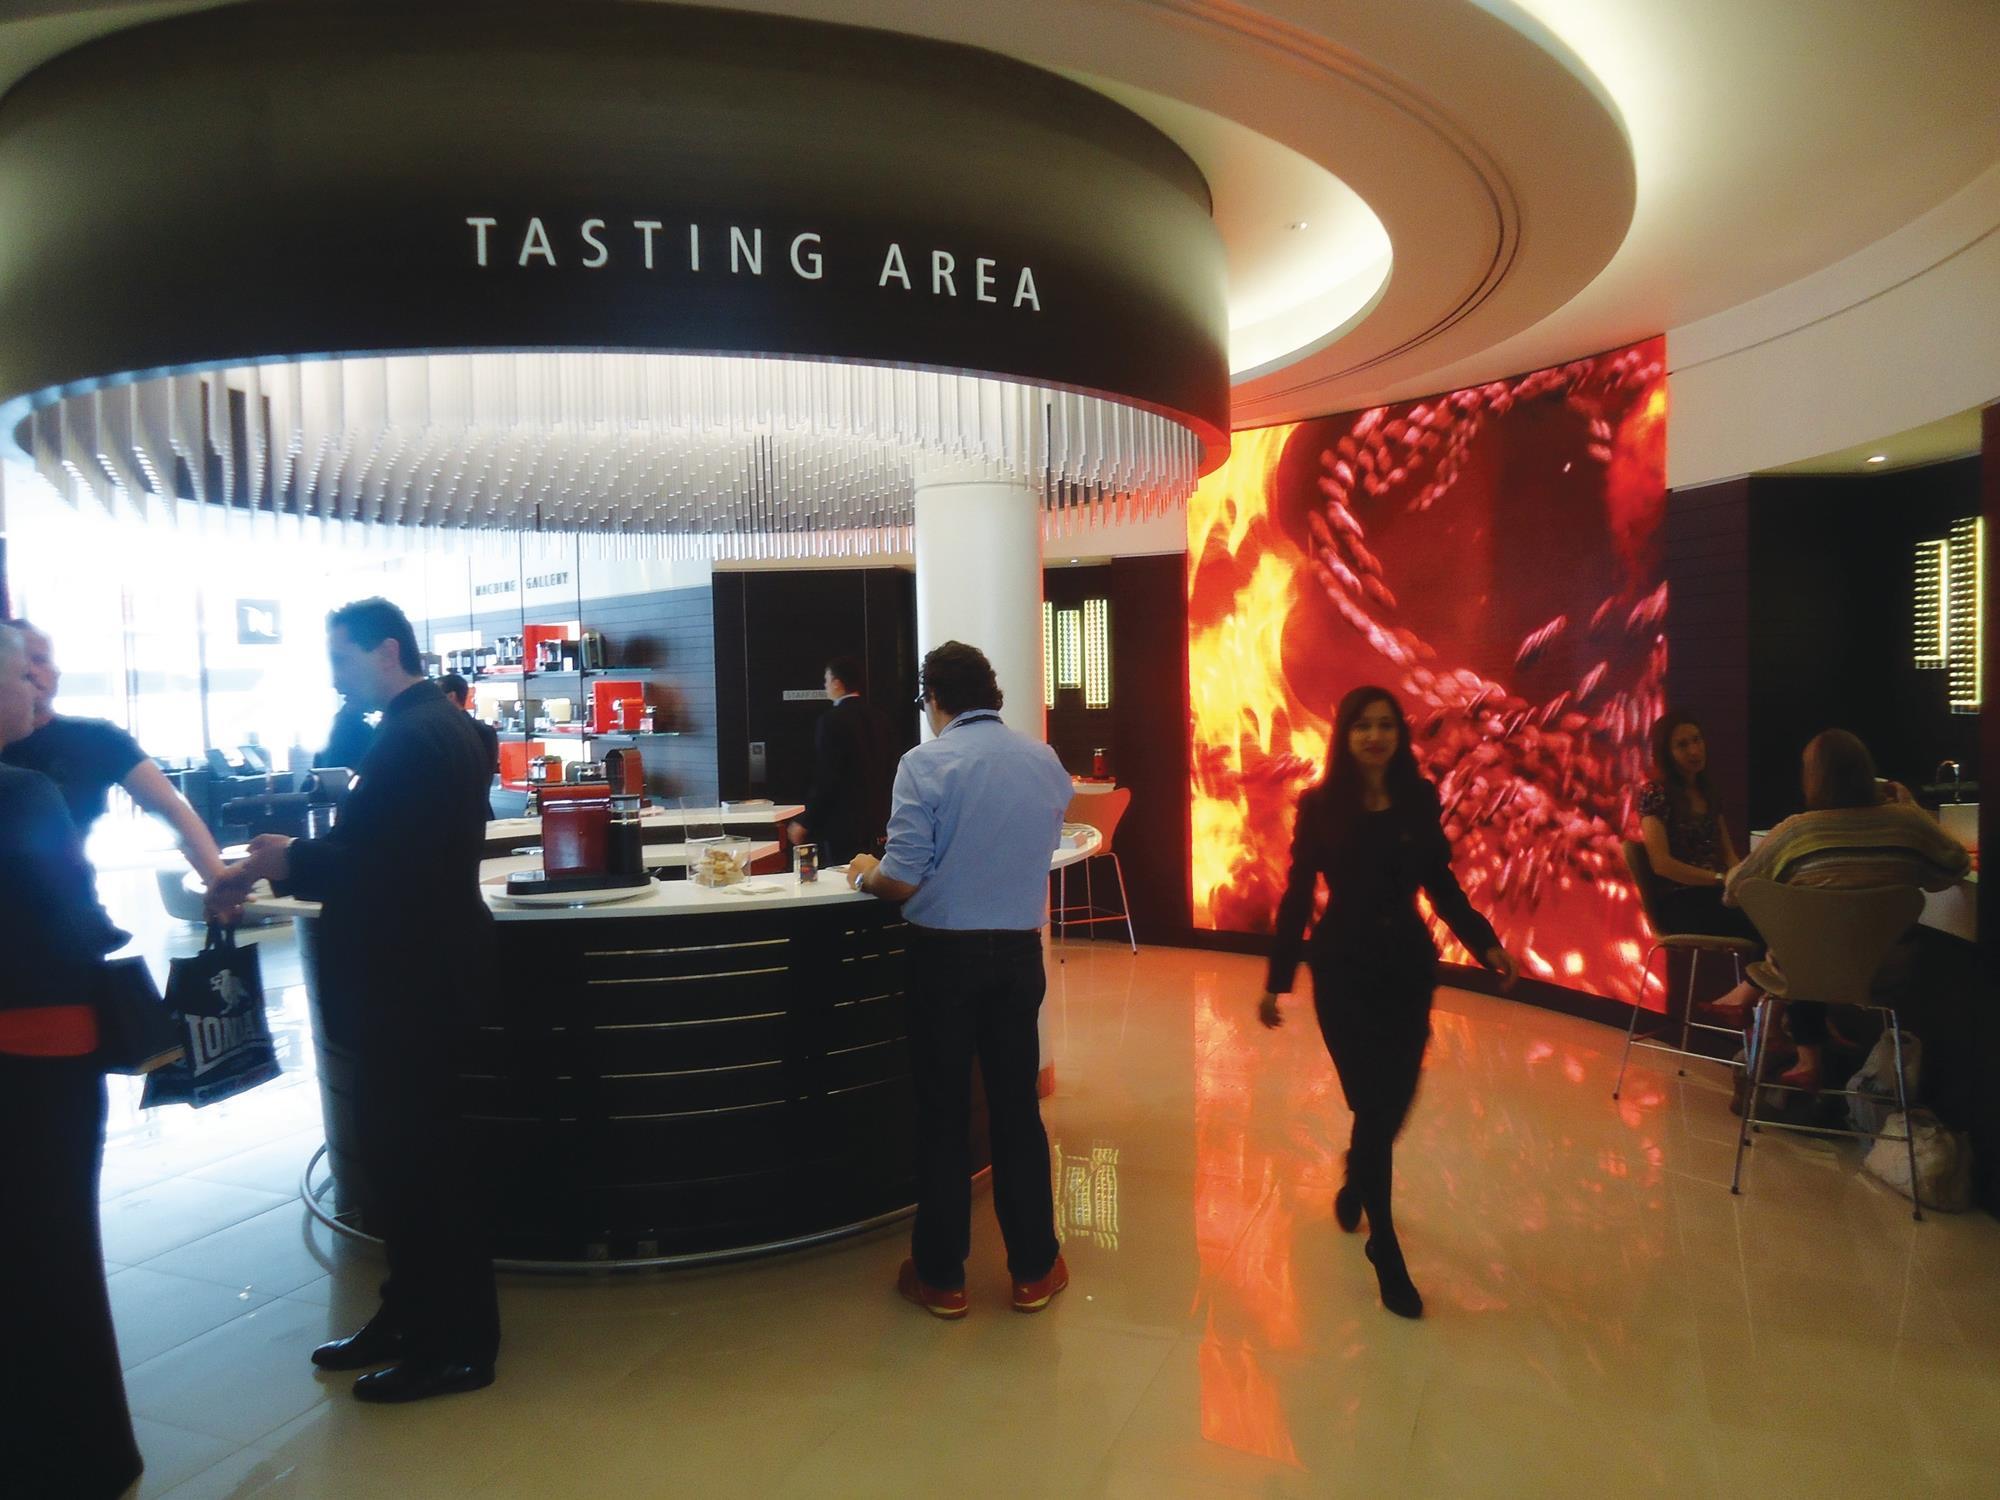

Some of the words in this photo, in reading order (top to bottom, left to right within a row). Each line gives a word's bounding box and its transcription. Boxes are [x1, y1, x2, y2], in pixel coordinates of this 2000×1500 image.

[467, 217, 823, 280] TASTING
[879, 243, 1041, 311] AREA
[526, 572, 568, 589] GALLERY
